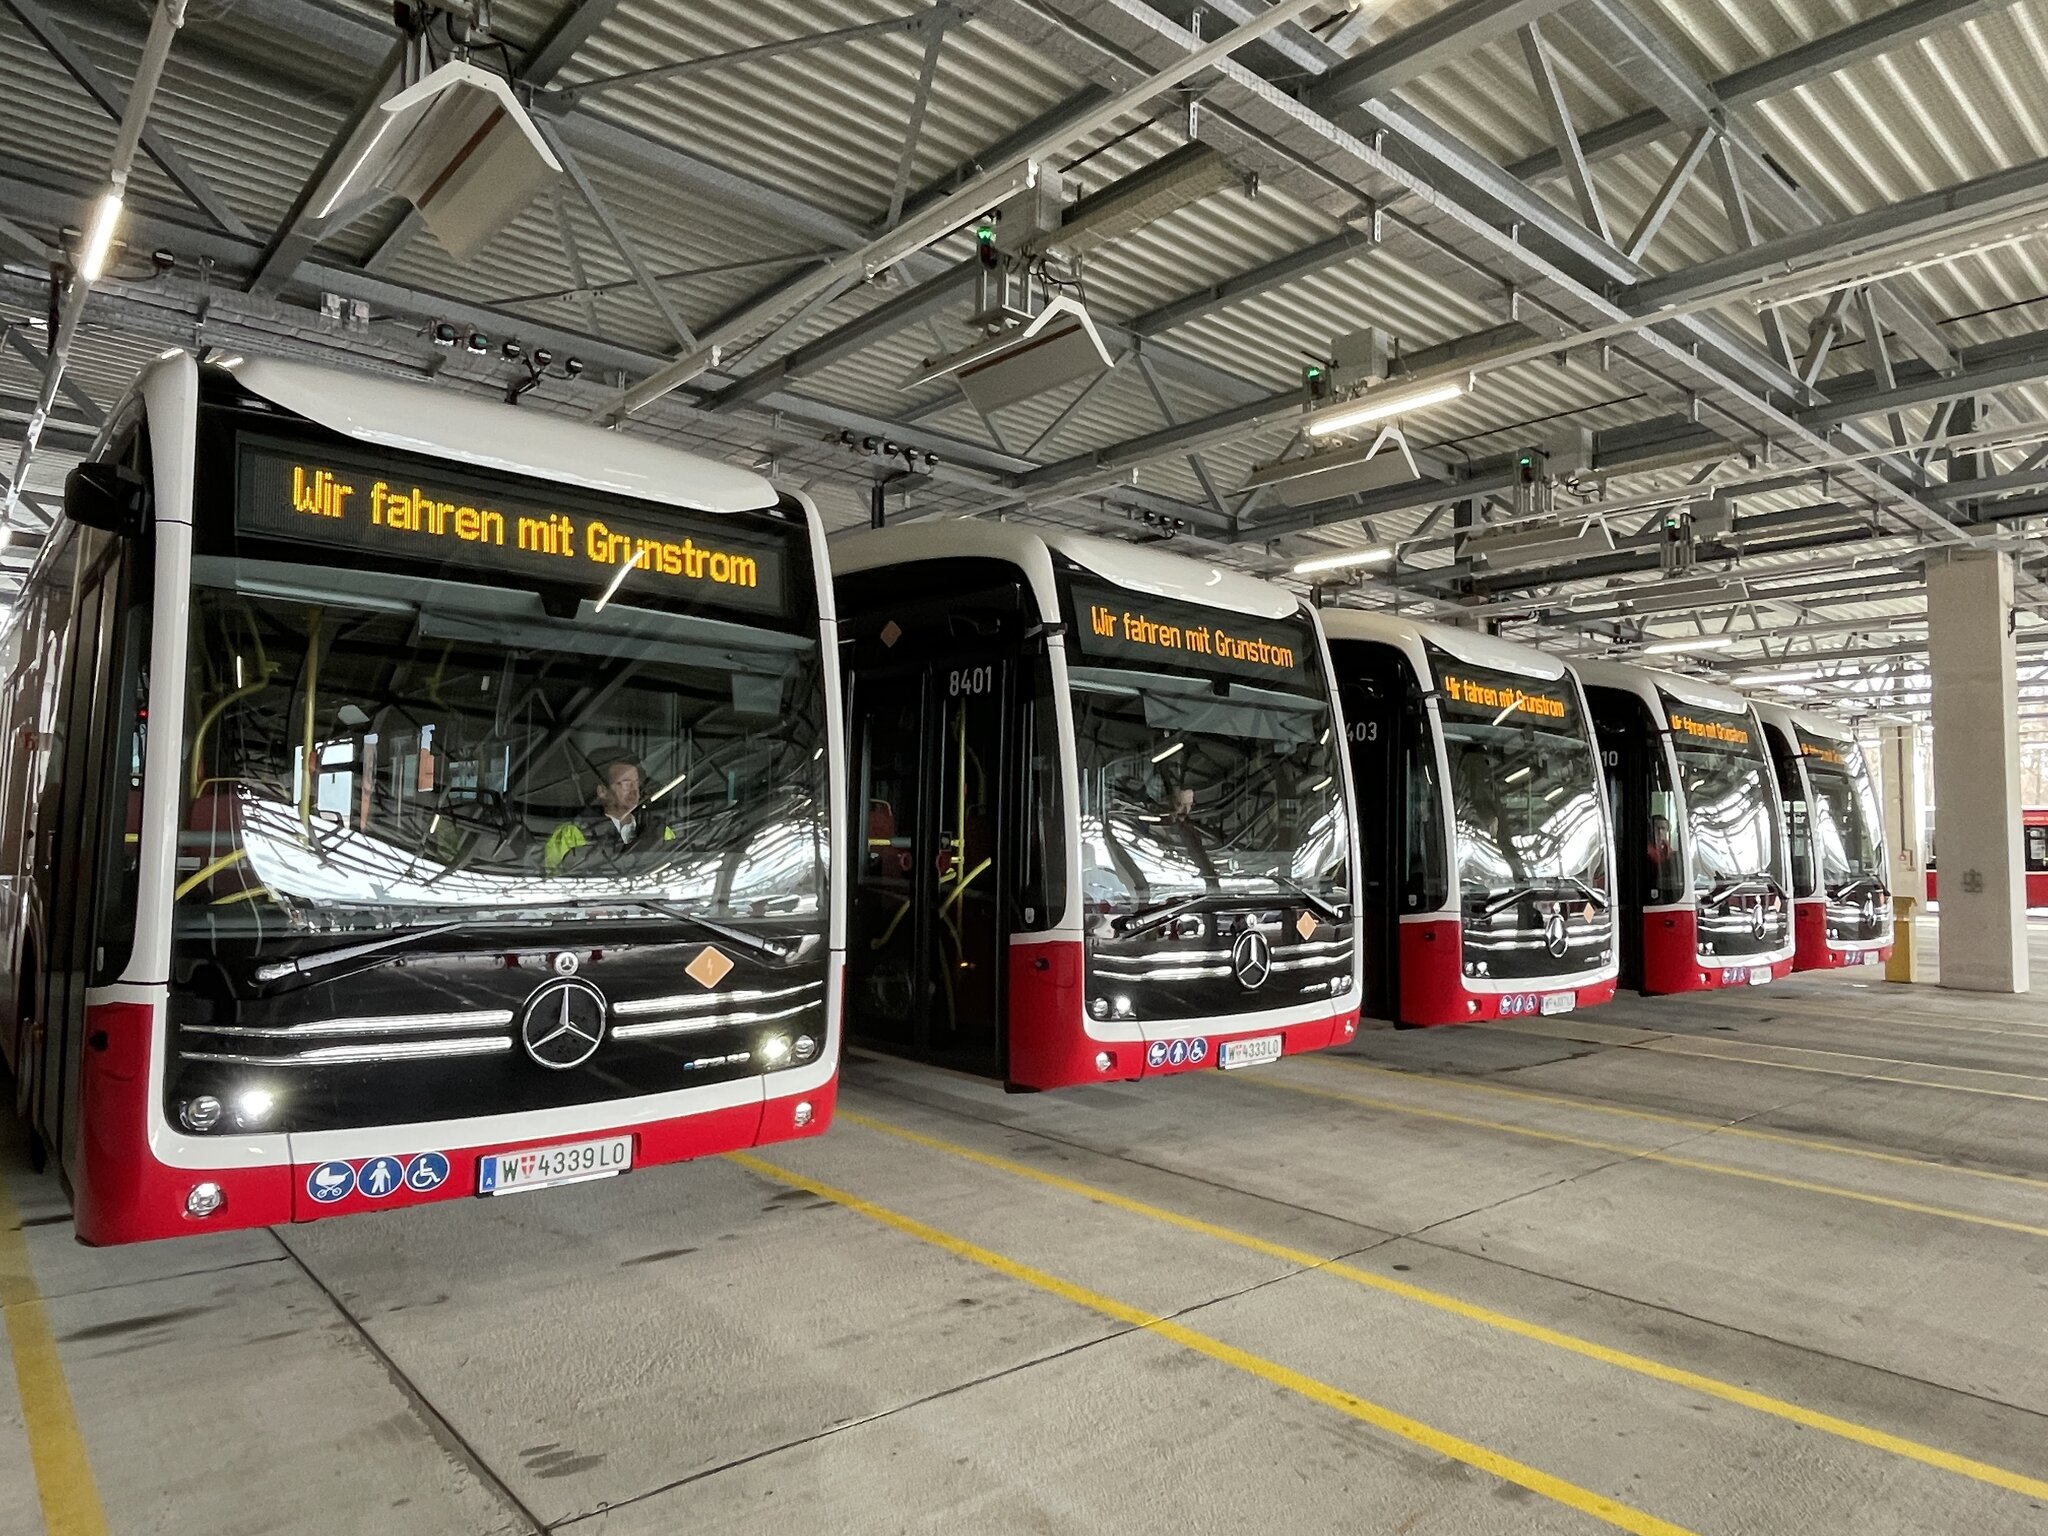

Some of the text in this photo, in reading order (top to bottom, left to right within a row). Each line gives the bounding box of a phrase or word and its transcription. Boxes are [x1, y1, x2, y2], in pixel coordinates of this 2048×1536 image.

[293, 466, 354, 518] Wir
[370, 481, 504, 546] fahren
[518, 513, 575, 558] mit
[1090, 605, 1118, 638] Wir
[1123, 611, 1182, 649] fahren
[1185, 626, 1212, 655] mit
[949, 665, 992, 696] 8401
